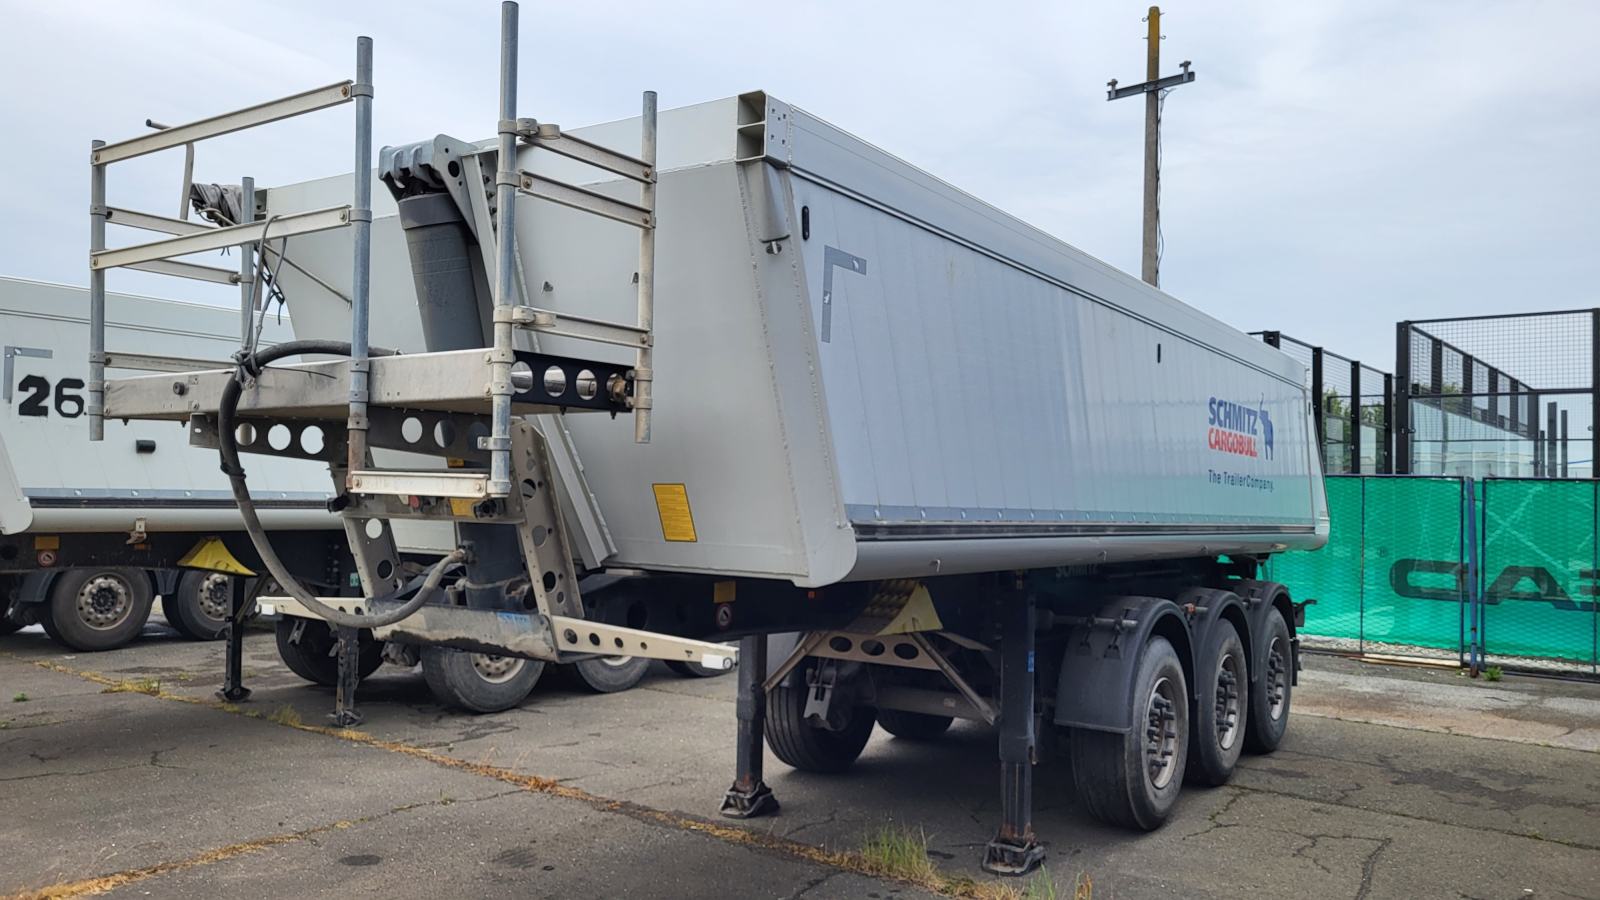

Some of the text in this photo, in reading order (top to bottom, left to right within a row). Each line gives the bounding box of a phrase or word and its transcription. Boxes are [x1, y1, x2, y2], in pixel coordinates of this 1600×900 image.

[1208, 397, 1258, 435] SCHMITZ
[1208, 427, 1258, 457] CARGOBULL
[1207, 469, 1221, 484] The
